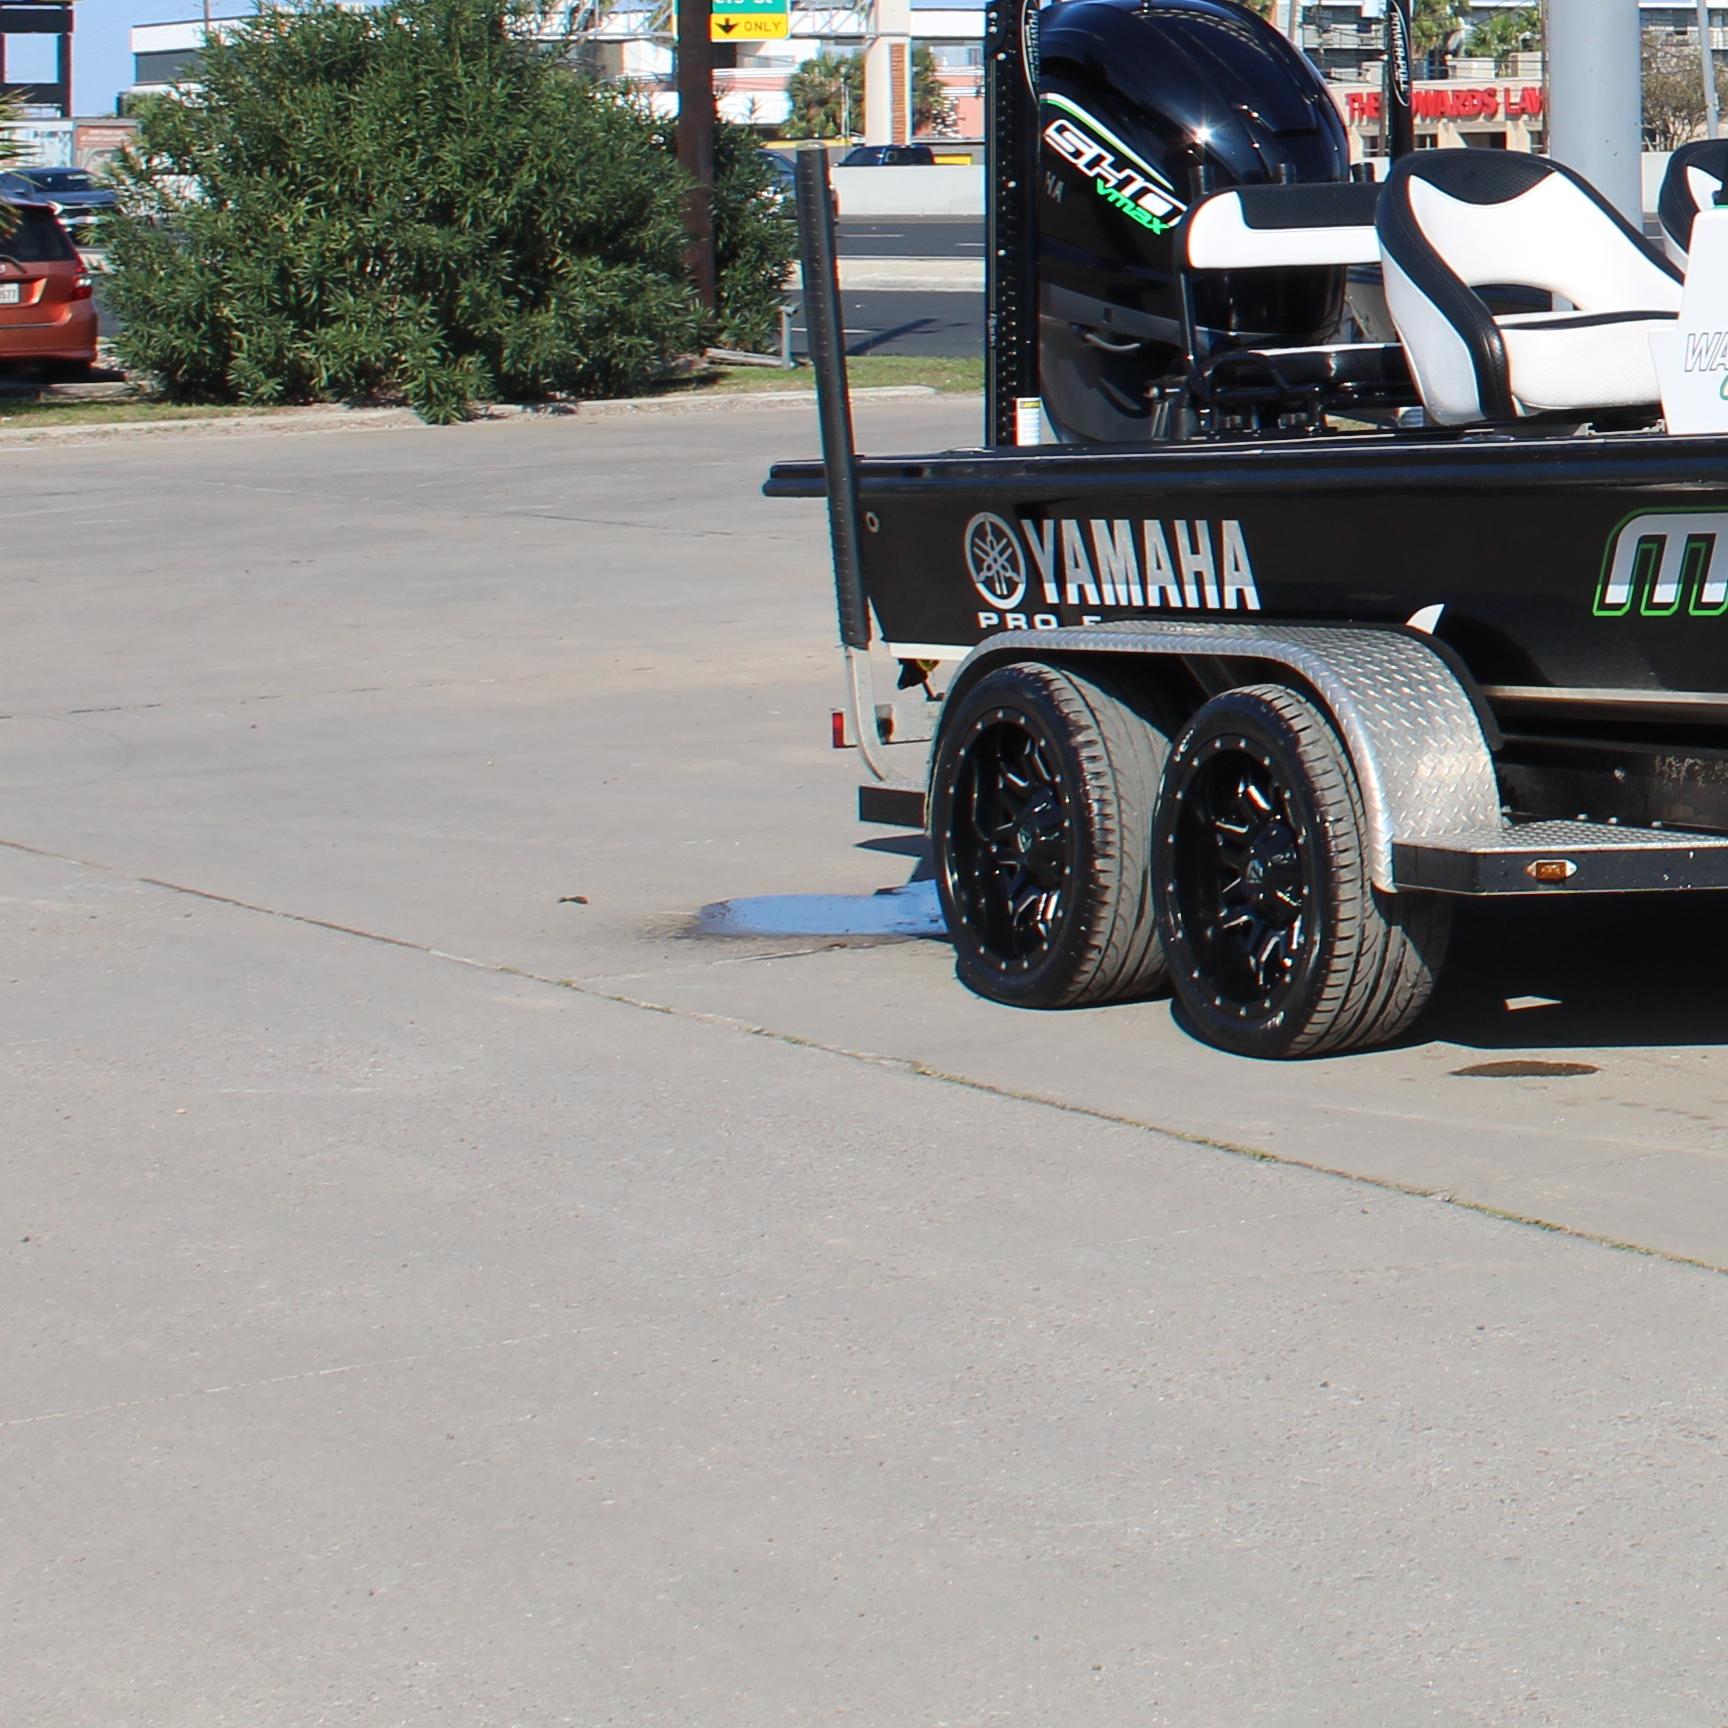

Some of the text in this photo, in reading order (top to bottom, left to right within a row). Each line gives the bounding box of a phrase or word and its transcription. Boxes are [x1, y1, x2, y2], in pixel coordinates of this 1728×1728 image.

[743, 21, 781, 32] ONLY
[1345, 92, 1383, 119] THE
[1043, 118, 1188, 228] SHO
[1020, 519, 1261, 611] YAMAHA
[977, 611, 1059, 629] PRO
